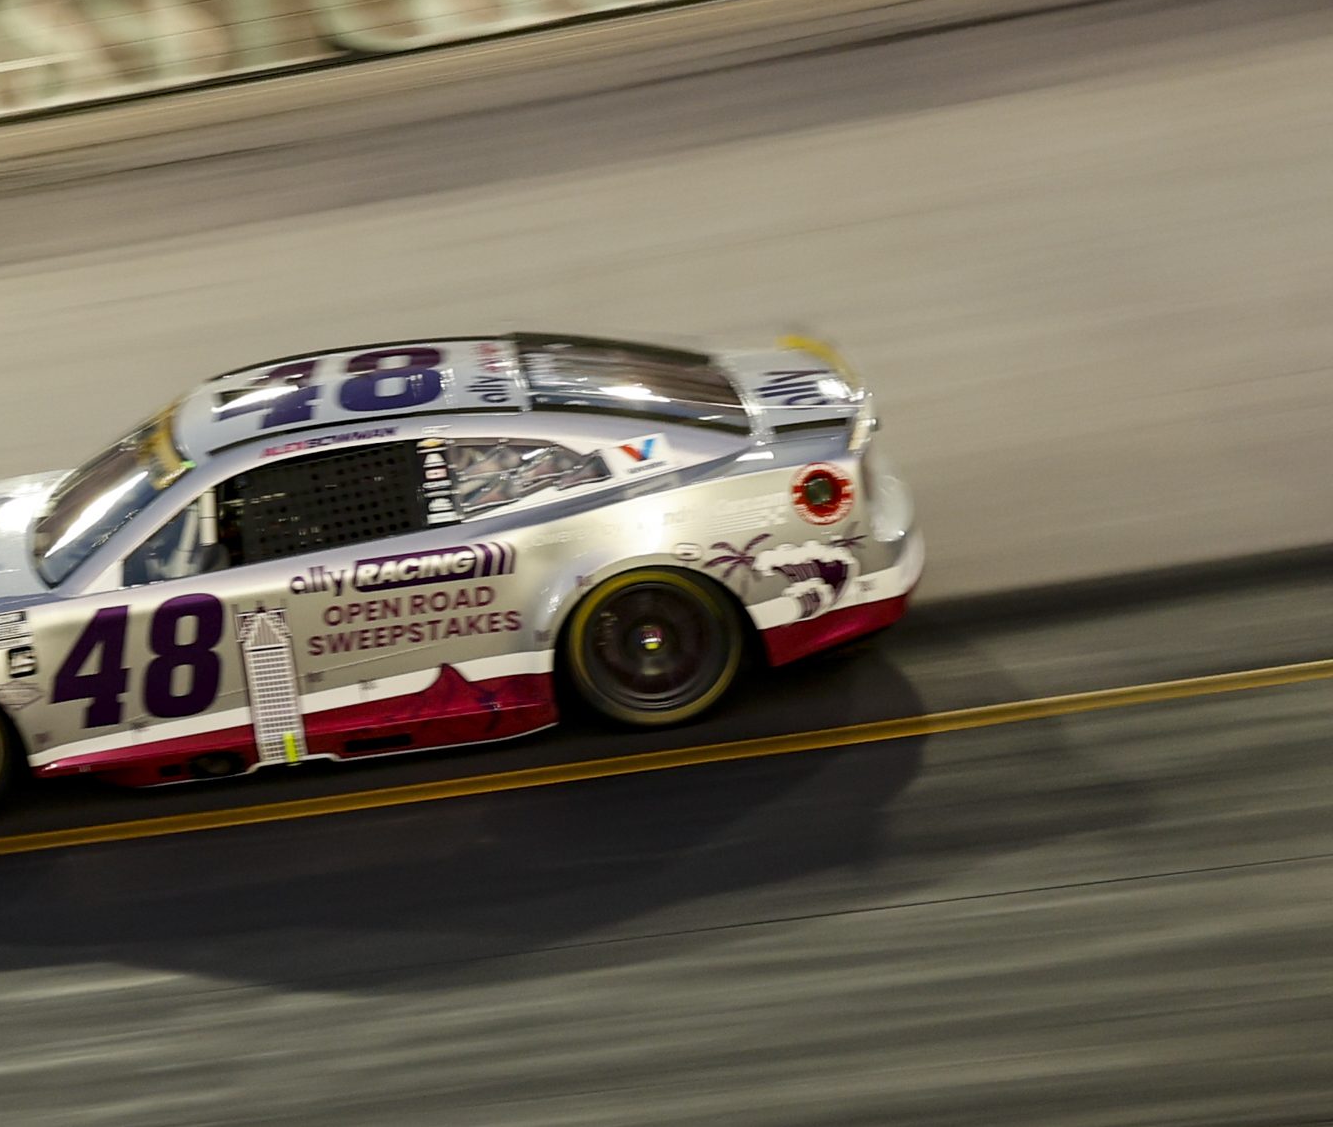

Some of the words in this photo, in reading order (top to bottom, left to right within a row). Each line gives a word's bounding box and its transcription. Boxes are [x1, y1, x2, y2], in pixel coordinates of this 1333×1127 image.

[211, 347, 442, 429] 48
[290, 565, 347, 596] ally
[355, 550, 477, 587] RACING
[323, 597, 402, 626] OPEN
[410, 585, 495, 615] ROAD
[307, 610, 523, 656] SWEEPSTAKES
[50, 593, 224, 729] 48
